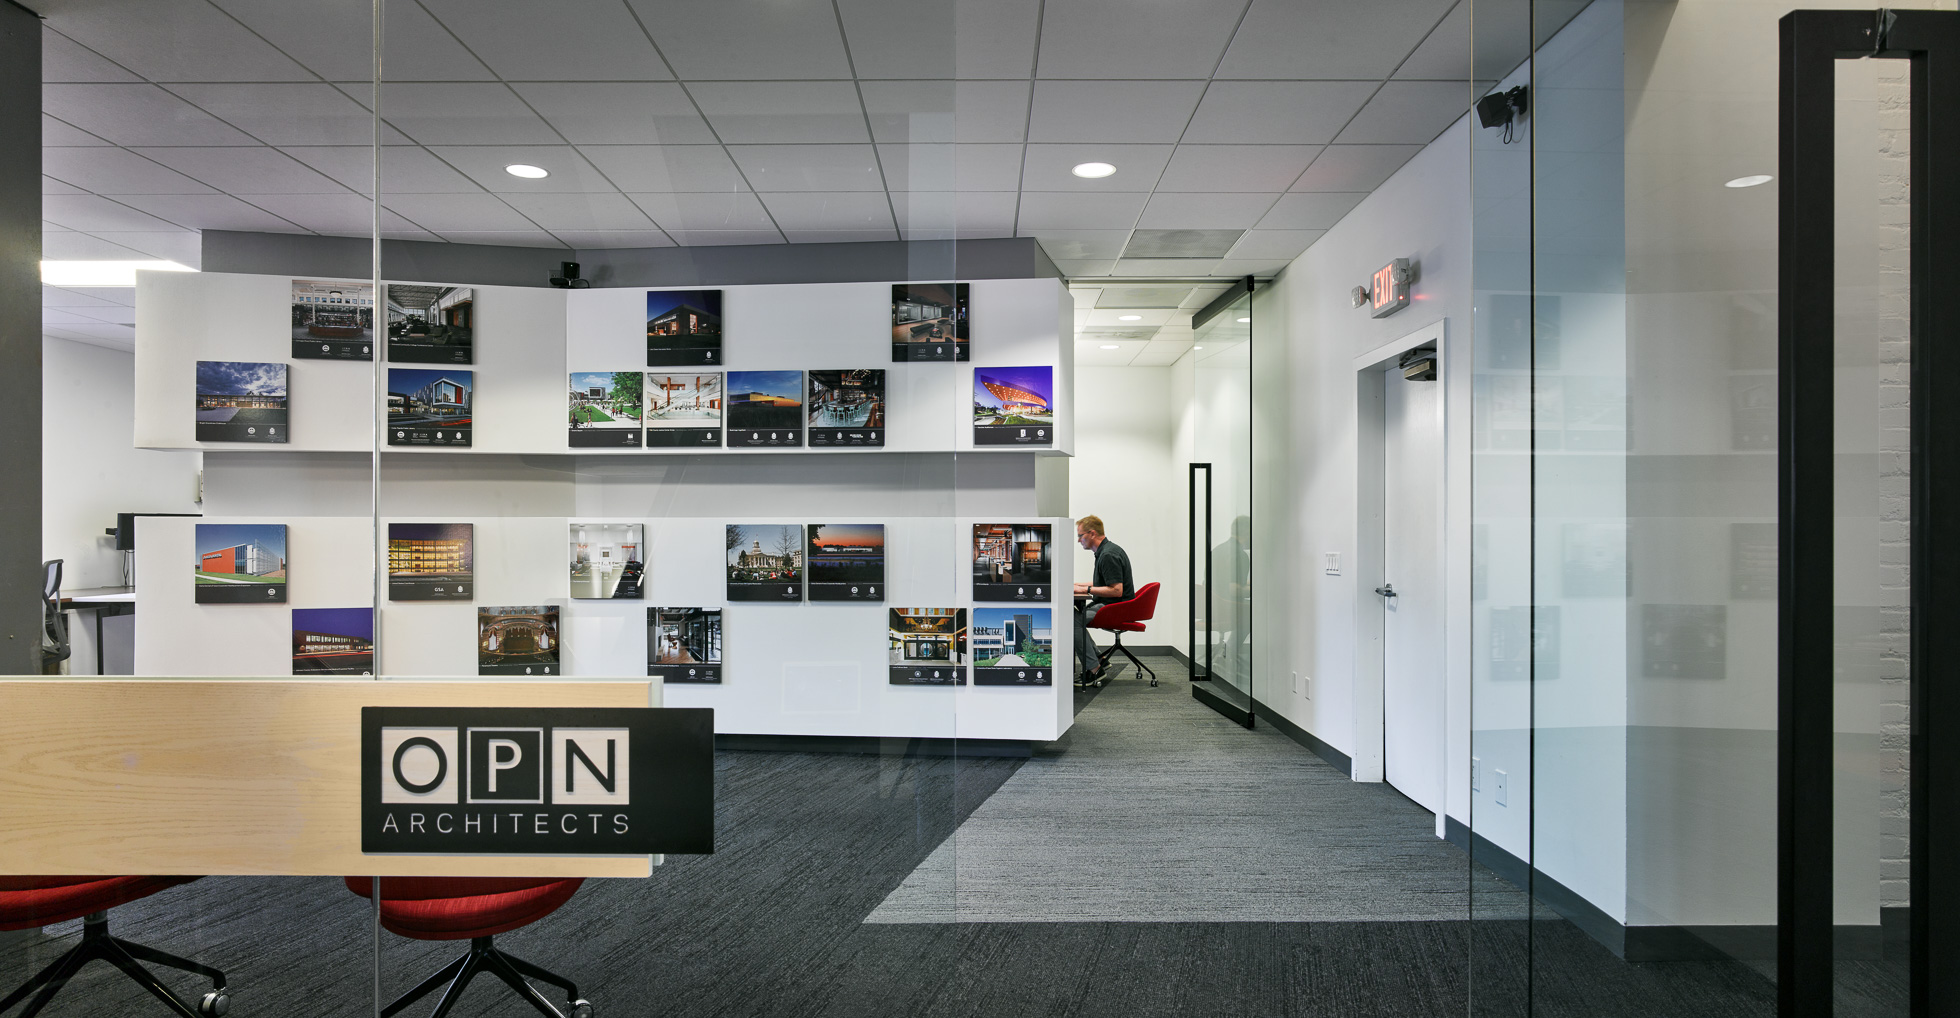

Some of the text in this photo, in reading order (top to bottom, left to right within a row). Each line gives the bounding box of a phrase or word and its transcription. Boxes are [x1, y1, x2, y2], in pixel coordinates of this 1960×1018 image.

[1374, 264, 1393, 309] EXIT
[392, 737, 616, 794] OPN
[382, 813, 629, 834] ARCHITECTS
